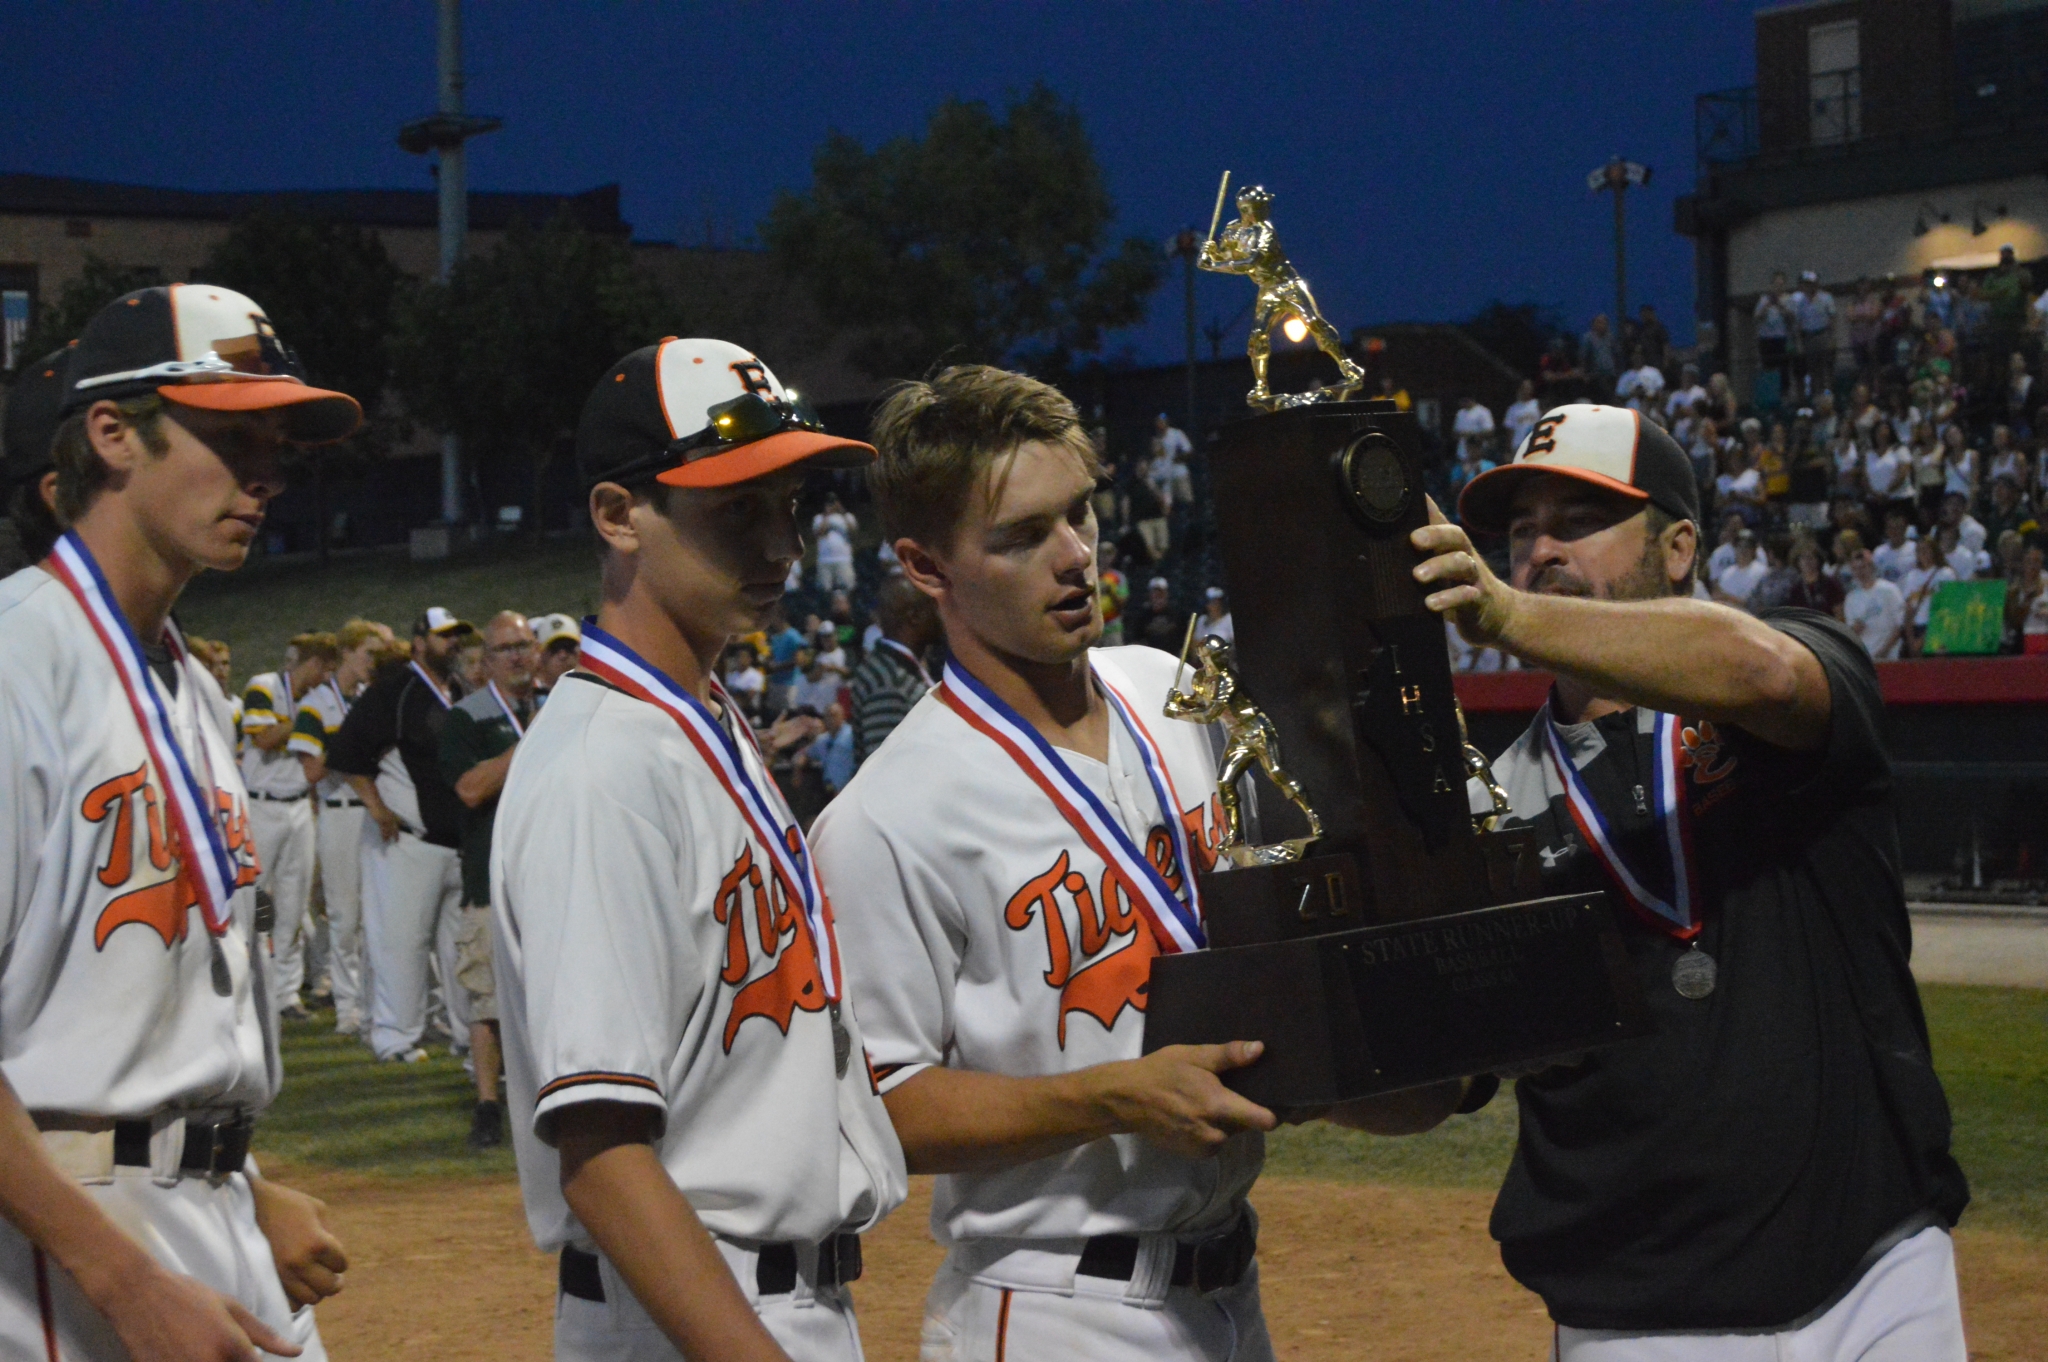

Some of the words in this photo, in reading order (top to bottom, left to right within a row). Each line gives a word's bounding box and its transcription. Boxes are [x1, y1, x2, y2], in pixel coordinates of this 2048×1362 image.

[1523, 413, 1566, 459] E
[1360, 930, 1440, 966] STATE
[1441, 906, 1579, 953] RUNNER-UP
